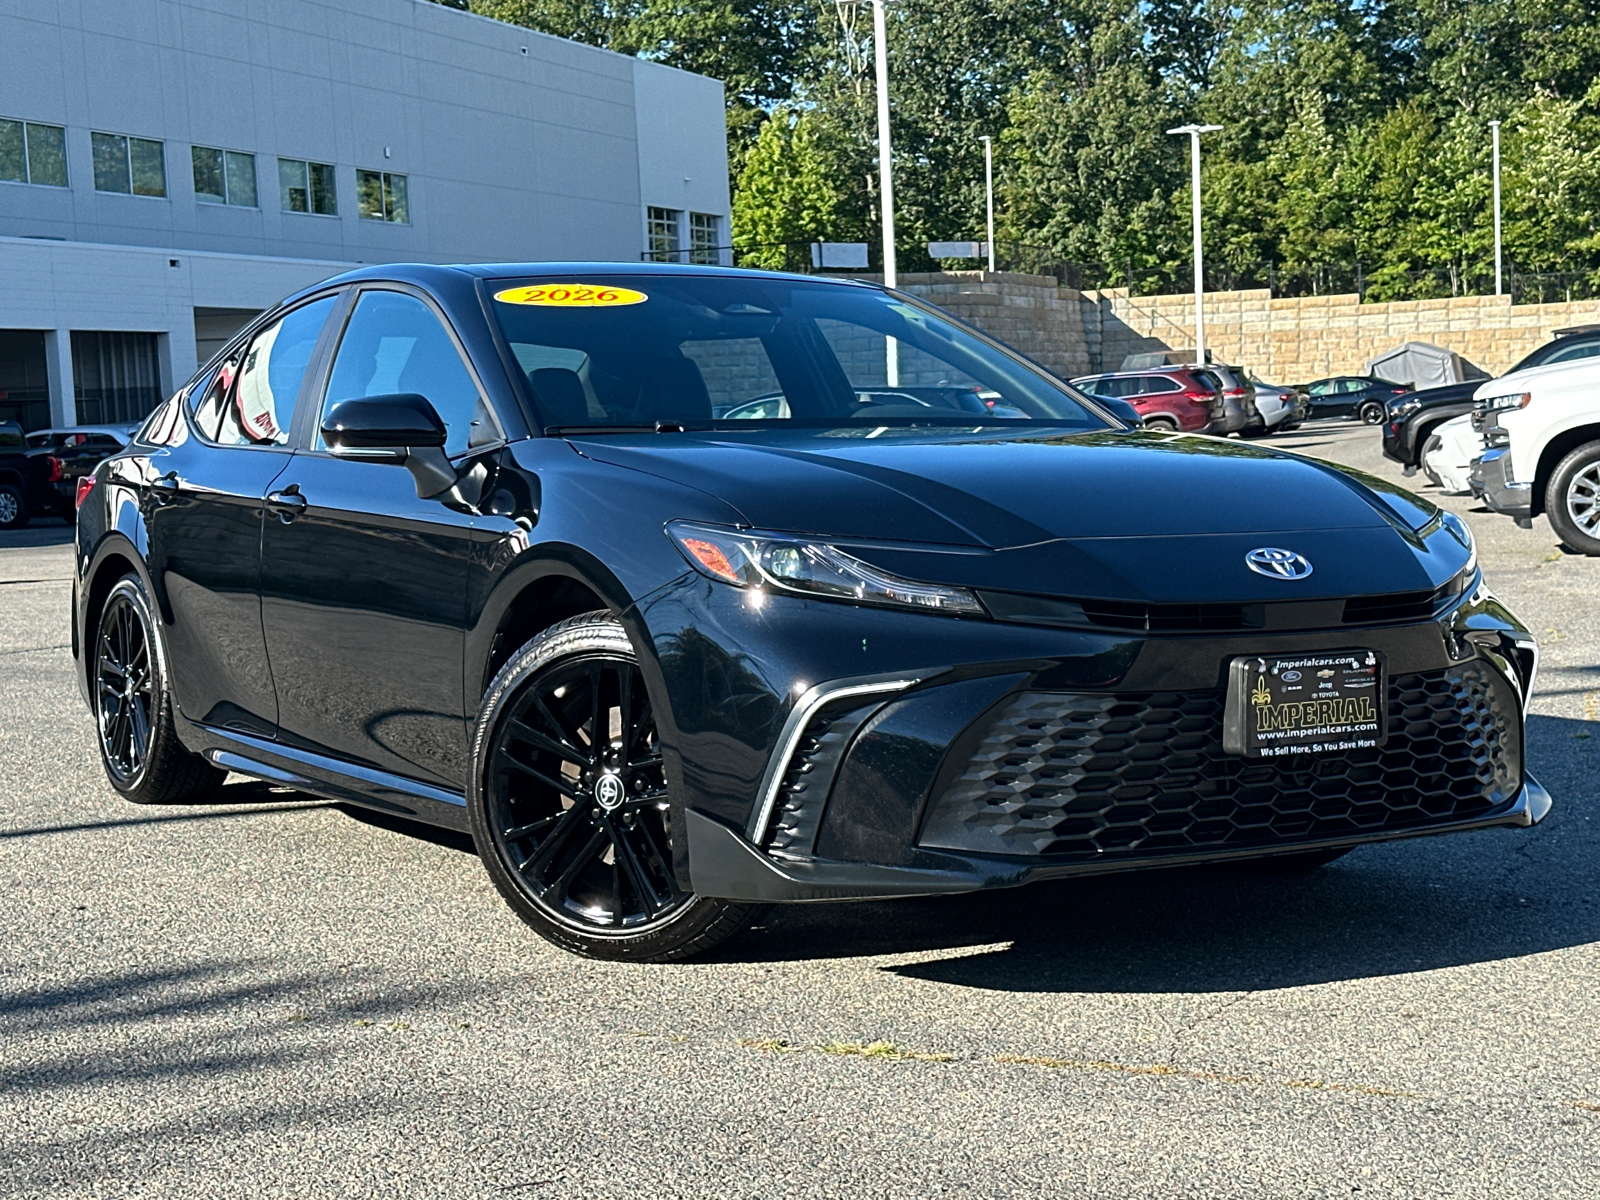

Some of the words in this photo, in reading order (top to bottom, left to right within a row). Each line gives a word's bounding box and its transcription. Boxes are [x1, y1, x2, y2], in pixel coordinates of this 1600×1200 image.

[524, 289, 620, 302] 2026
[1276, 657, 1355, 670] Imperialcars.com
[1256, 697, 1377, 731] IMPERIAL
[1257, 723, 1377, 740] www.imperialcars.com
[1260, 748, 1274, 757] We
[1274, 746, 1289, 756] Sell
[1290, 745, 1311, 754] More,
[1312, 743, 1323, 752] So
[1324, 743, 1338, 751] You
[1339, 741, 1357, 750] Save
[1357, 739, 1376, 748] More
